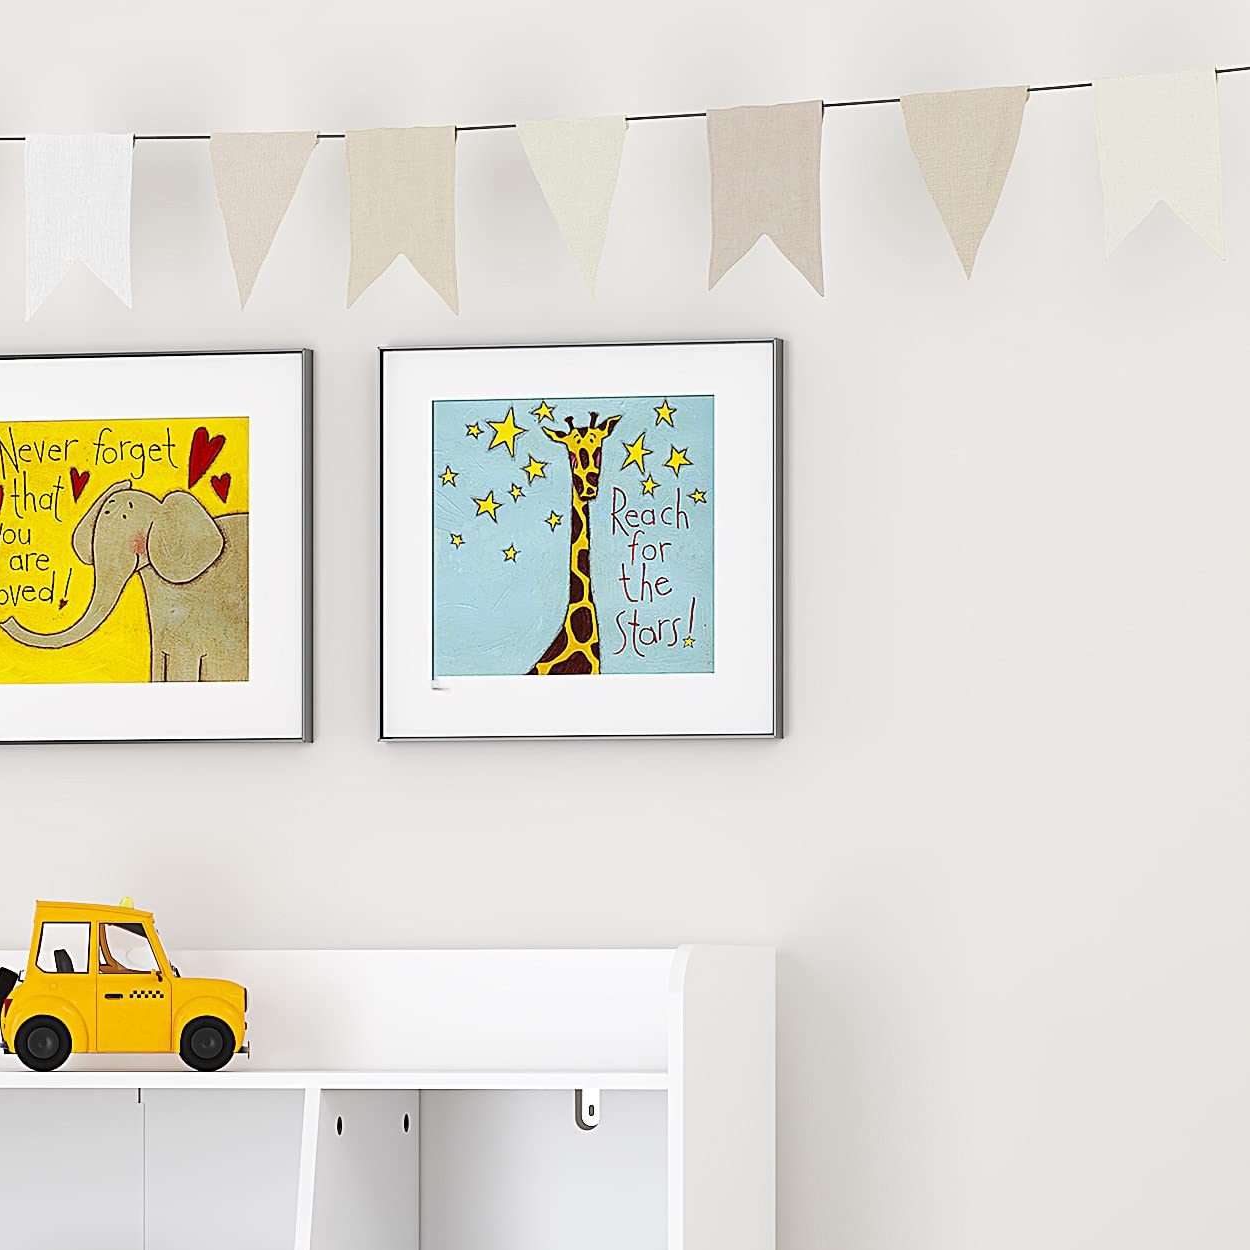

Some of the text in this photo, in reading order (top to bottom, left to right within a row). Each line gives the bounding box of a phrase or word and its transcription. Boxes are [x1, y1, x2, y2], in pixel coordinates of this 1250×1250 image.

[93, 427, 178, 480] forget
[10, 470, 64, 522] that
[611, 487, 690, 537] Reach
[9, 552, 50, 572] are
[628, 530, 672, 566] for
[618, 563, 673, 603] the
